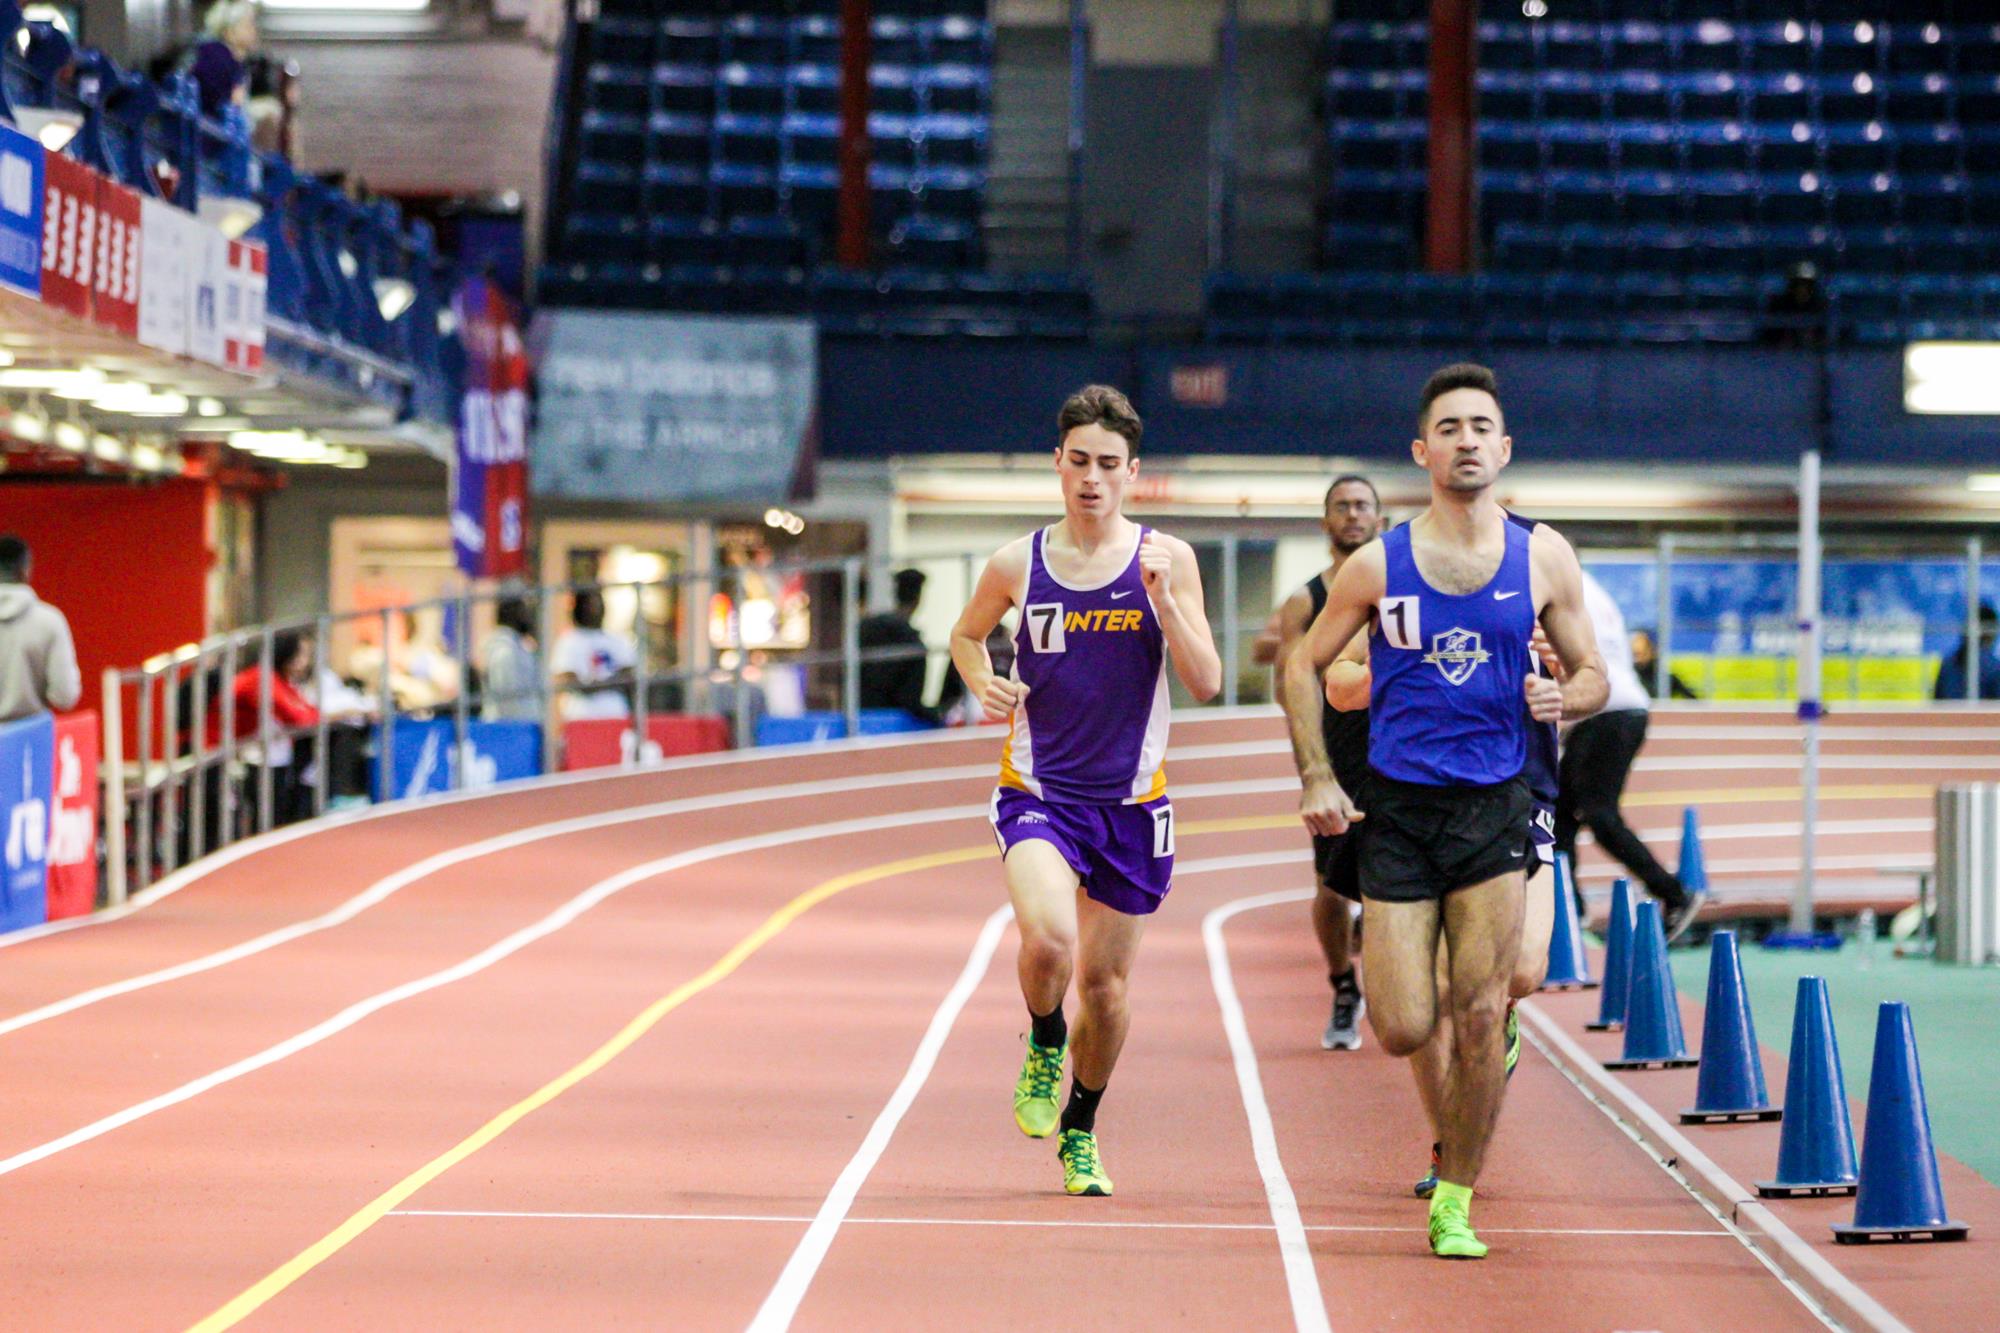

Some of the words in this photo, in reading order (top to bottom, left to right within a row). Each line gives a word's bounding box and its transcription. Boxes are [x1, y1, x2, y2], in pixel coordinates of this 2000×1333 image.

[1031, 608, 1057, 649] 7
[1388, 601, 1408, 646] 1
[1157, 810, 1170, 853] 7
